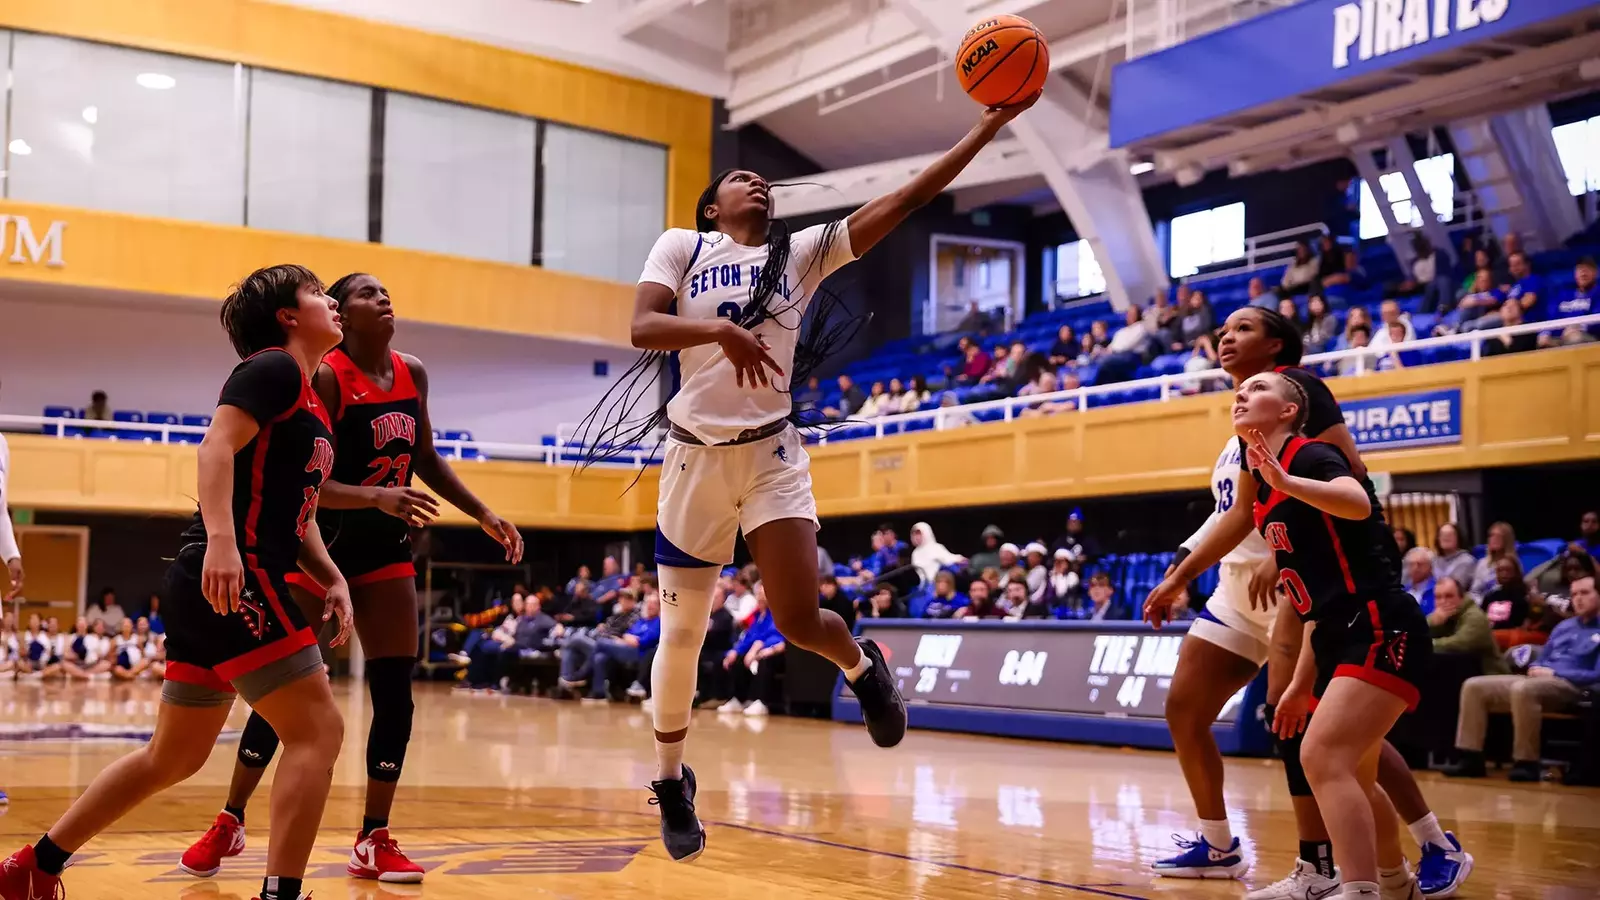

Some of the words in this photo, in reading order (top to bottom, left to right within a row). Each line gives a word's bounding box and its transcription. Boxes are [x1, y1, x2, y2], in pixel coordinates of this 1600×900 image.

[962, 38, 999, 77] NCAA
[691, 264, 741, 299] SETON
[750, 265, 791, 302] HL
[371, 411, 416, 450] UNLV
[1342, 399, 1451, 431] PIRATE
[1350, 423, 1452, 442] SKETBALL
[361, 453, 412, 488] 23
[1217, 477, 1233, 513] 13
[1089, 635, 1139, 674] THE
